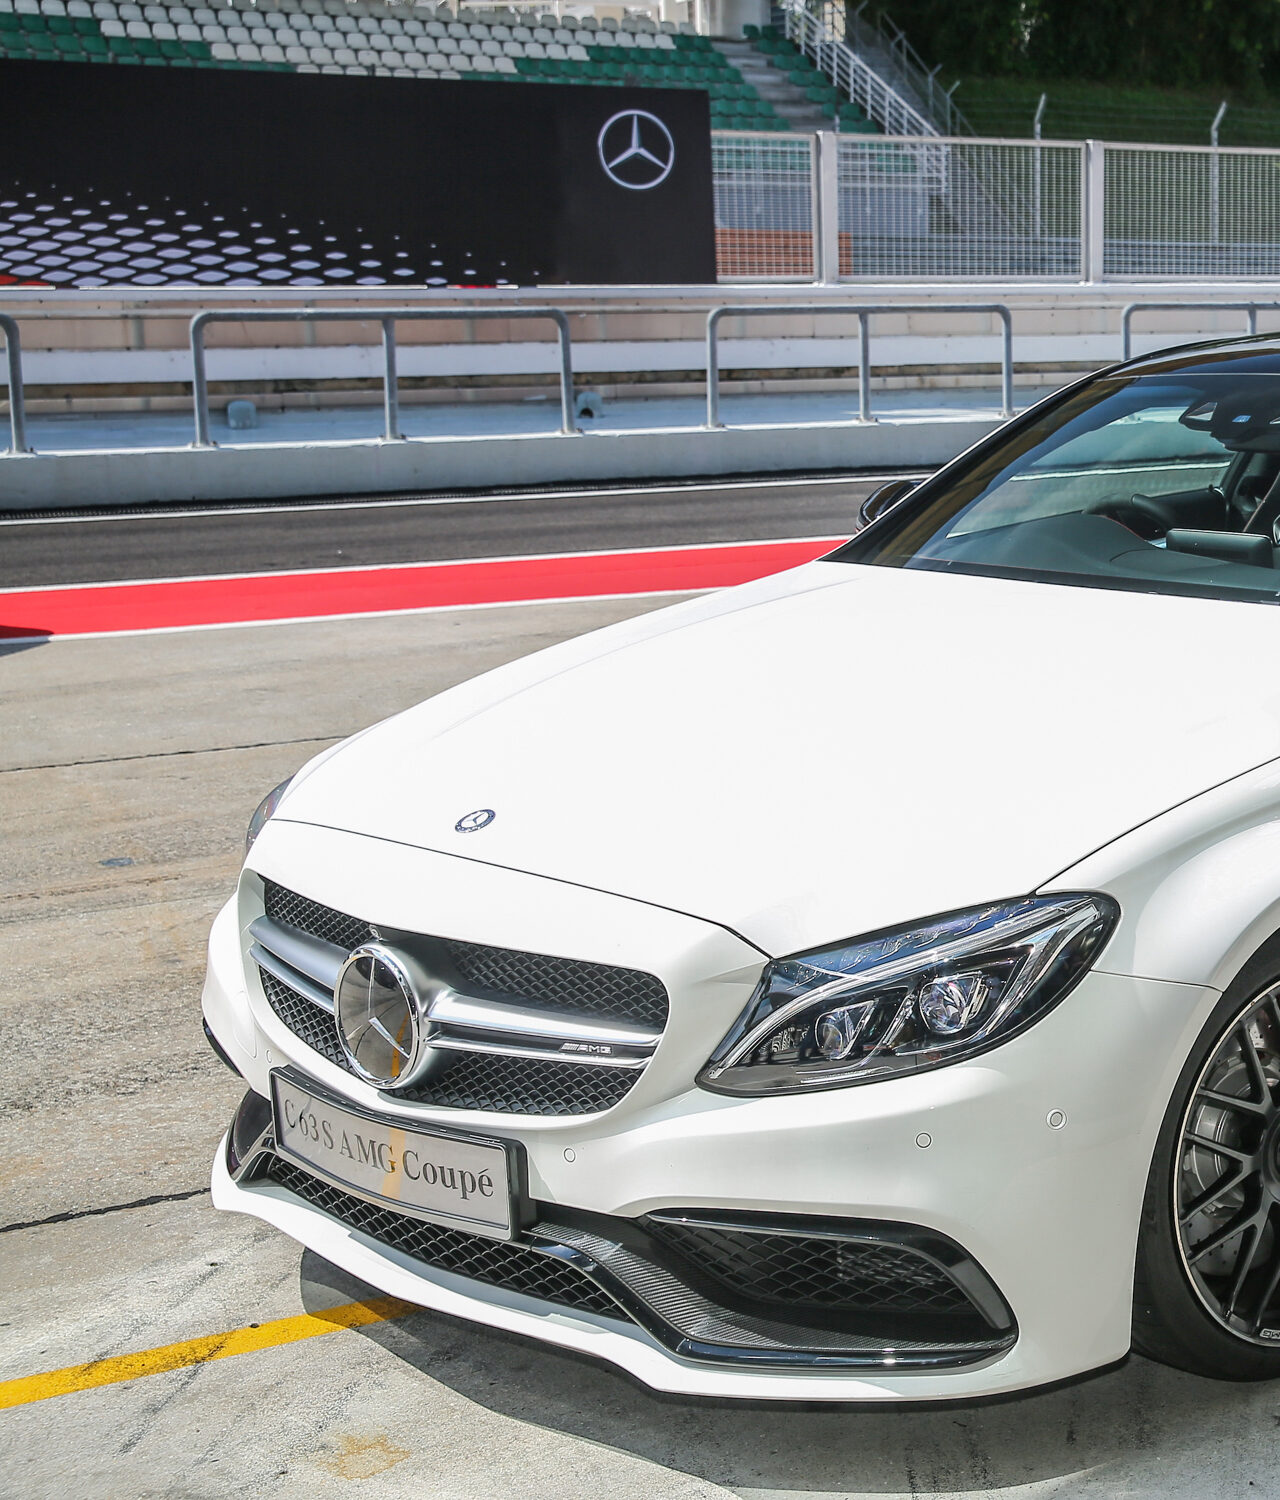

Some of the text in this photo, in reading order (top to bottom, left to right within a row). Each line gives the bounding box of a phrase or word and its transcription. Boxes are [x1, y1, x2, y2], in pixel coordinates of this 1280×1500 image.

[284, 1099, 296, 1129] C
[339, 1130, 397, 1175] AMG
[402, 1149, 494, 1200] Coupé
